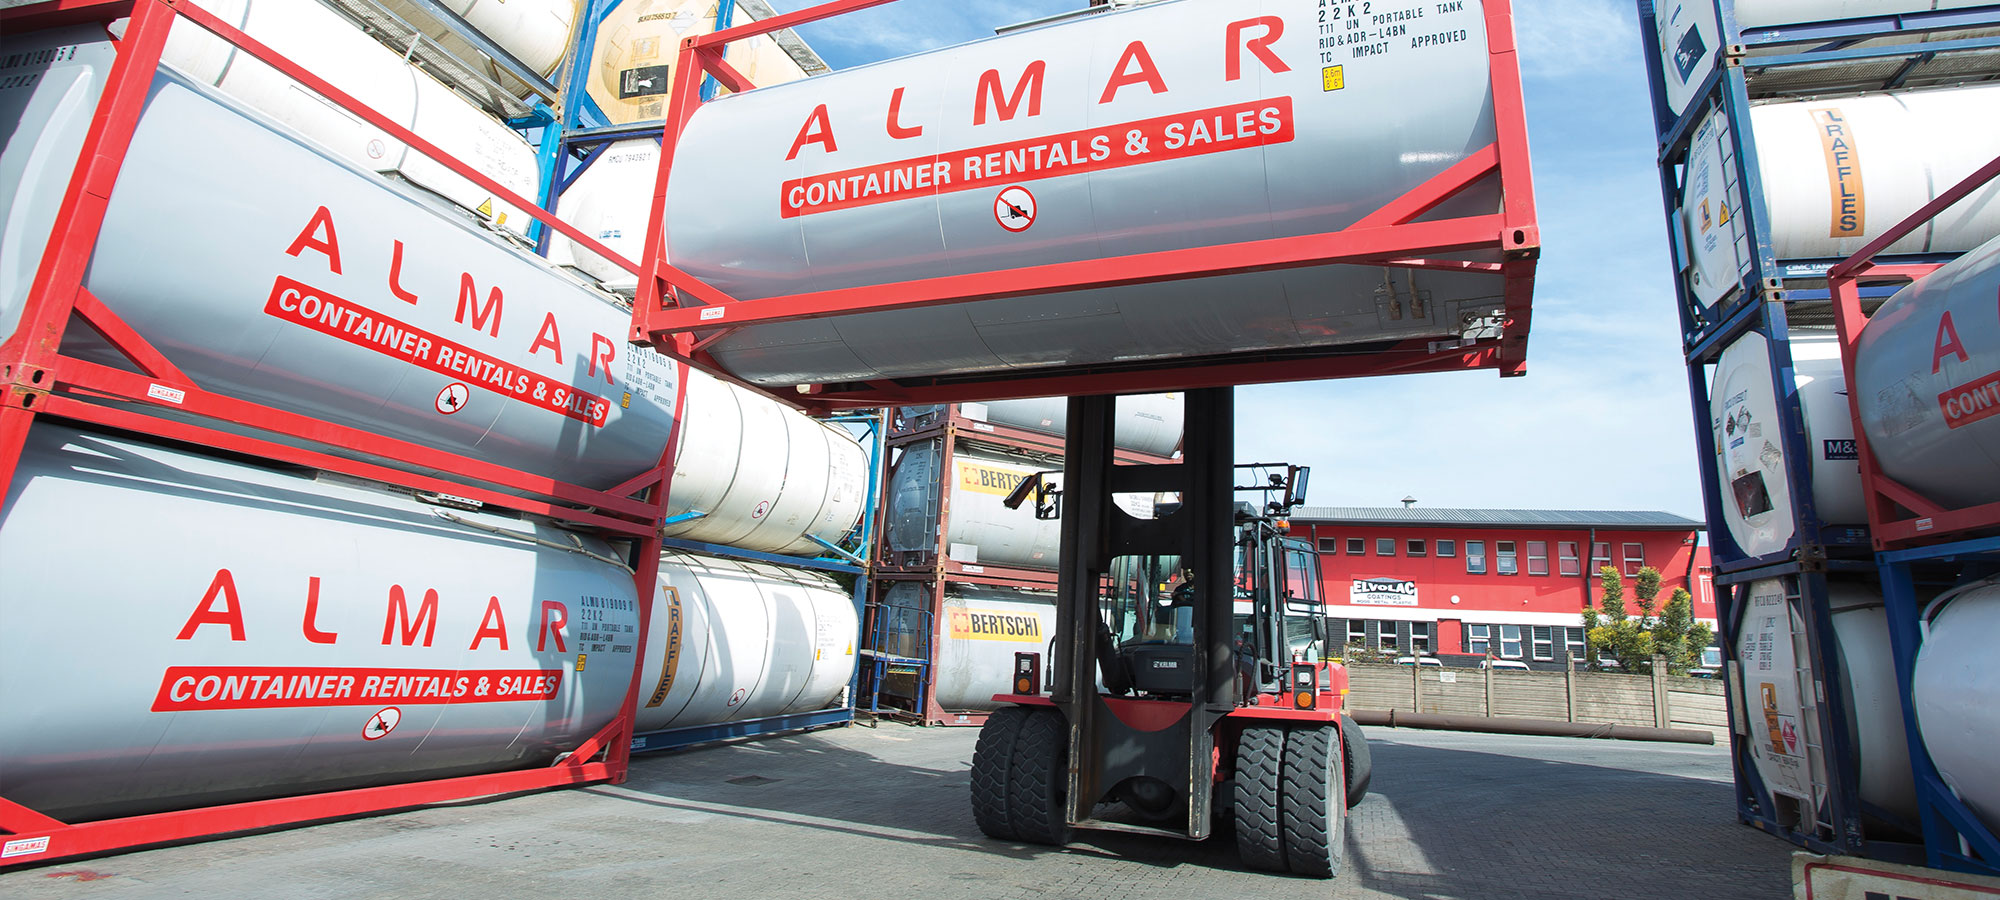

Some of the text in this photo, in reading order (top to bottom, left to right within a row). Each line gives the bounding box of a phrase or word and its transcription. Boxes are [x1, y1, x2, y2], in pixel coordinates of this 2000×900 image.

[1319, 1, 1464, 35] T11 UN PORTABLE TANK
[1320, 29, 1467, 63] TC IMPACT APPROVED
[785, 15, 1292, 161] ALMAR
[788, 105, 1282, 208] CONTAINER RENTALS & SALES
[1825, 124, 1857, 231] RAFFLES
[285, 205, 616, 386] ALMAR
[279, 288, 606, 421] CONTAINER RENTALS & SALES
[176, 569, 568, 654] ALMAR
[970, 613, 1039, 637] BERTSCHI
[1353, 580, 1415, 595] ELVOLAC
[169, 671, 557, 702] CONTAINER RENTALS & SALES
[652, 608, 680, 704] RAFFLES
